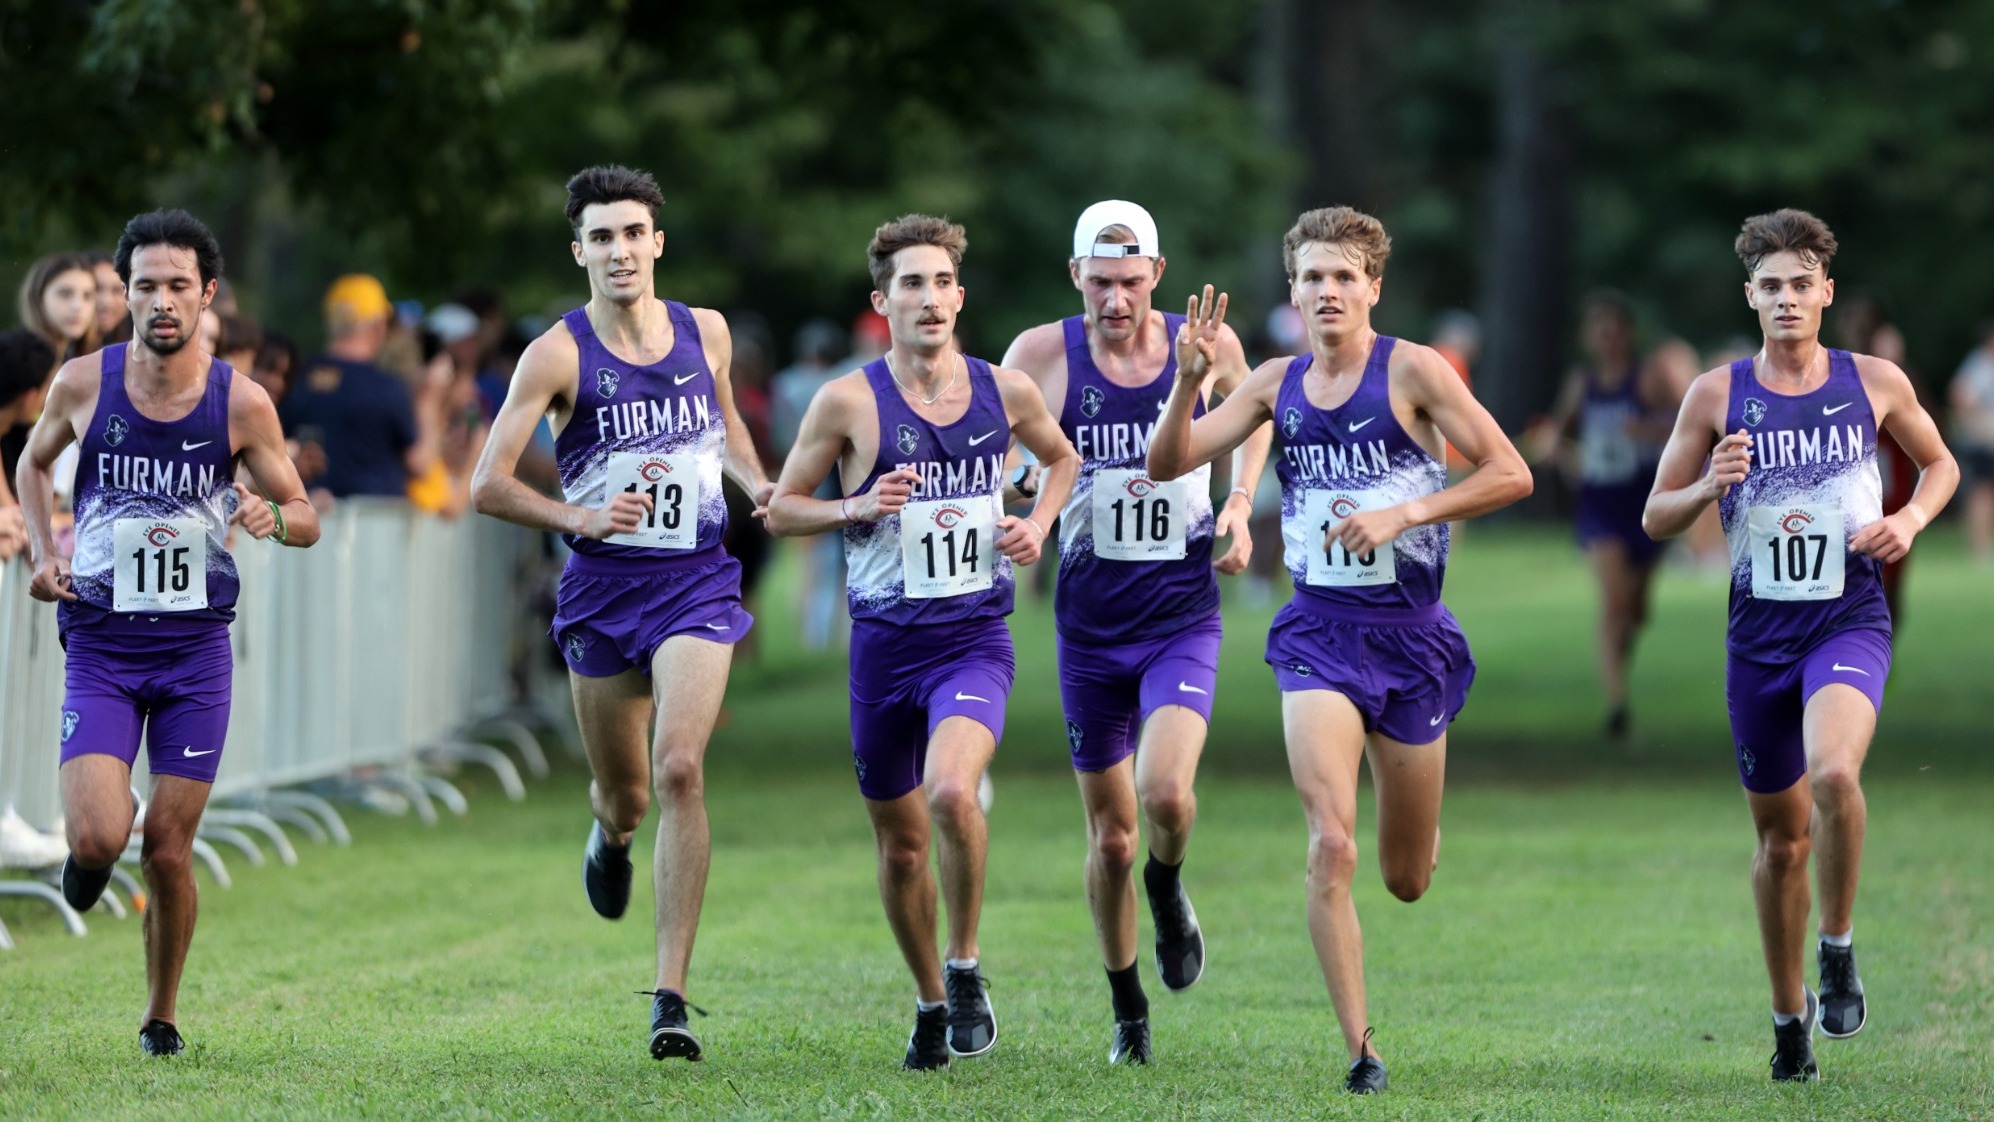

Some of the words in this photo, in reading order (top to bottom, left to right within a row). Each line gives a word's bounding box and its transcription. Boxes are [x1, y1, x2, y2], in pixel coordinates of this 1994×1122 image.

[596, 395, 709, 442] FURMAN
[1076, 422, 1155, 460] FURM
[98, 452, 215, 498] FURMAN
[649, 456, 674, 471] OPENER
[154, 522, 180, 537] OPENER
[941, 503, 968, 515] OPENER
[1111, 498, 1170, 541] 116
[1789, 508, 1815, 522] OPENER
[132, 546, 189, 594] 115
[921, 527, 979, 578] 114
[1768, 534, 1828, 582] 107
